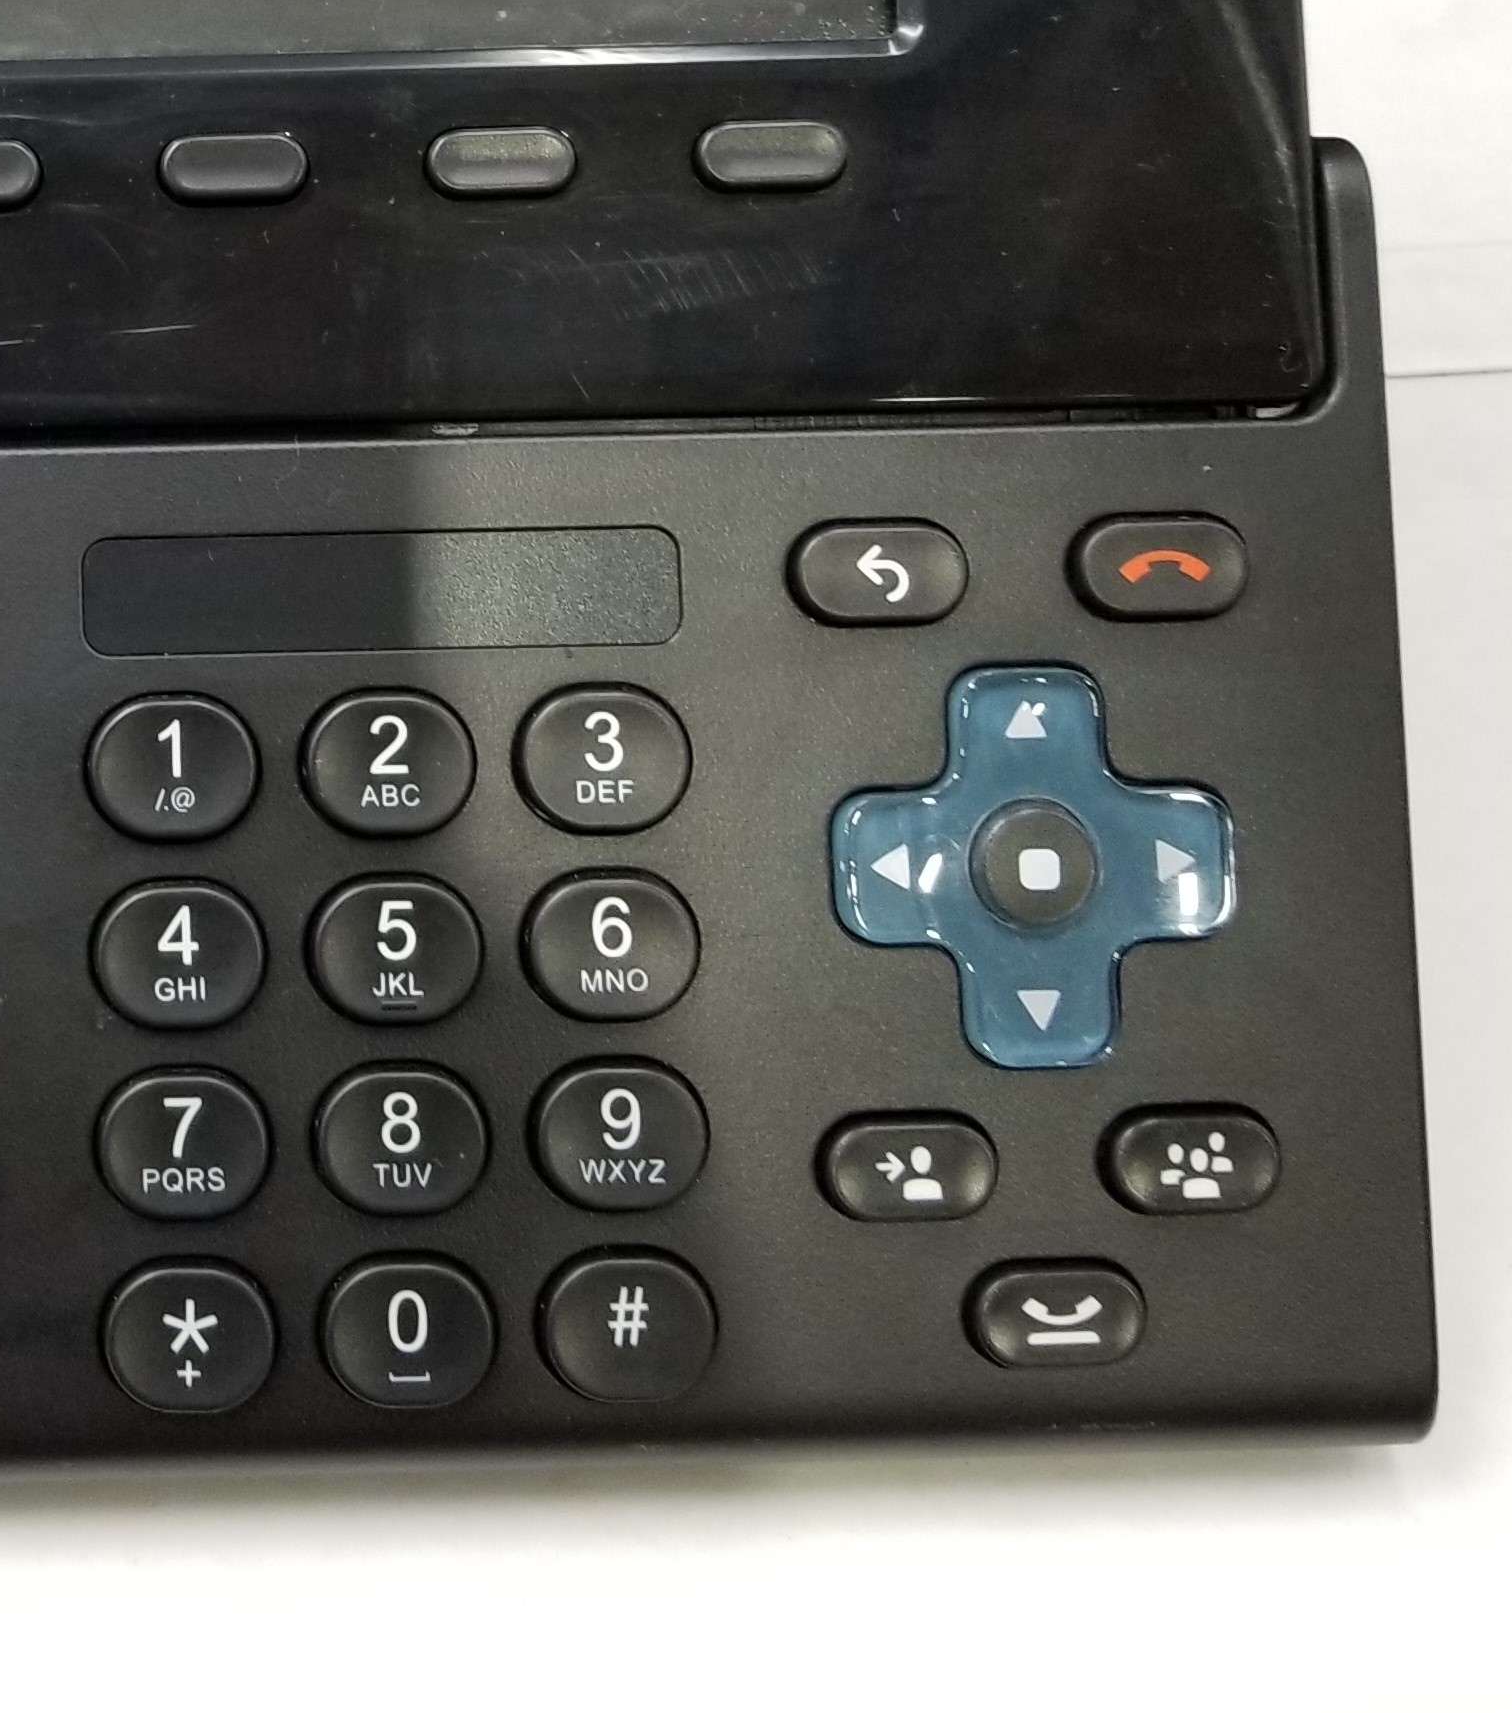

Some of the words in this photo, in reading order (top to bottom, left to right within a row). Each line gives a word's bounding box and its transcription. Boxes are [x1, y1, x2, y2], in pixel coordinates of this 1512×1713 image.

[157, 719, 182, 778] 1
[369, 714, 410, 775] 2
[583, 711, 625, 773] 3
[360, 783, 421, 808] ABC
[575, 779, 635, 804] DEF
[157, 905, 200, 966] 4
[376, 900, 417, 962] 5
[591, 896, 633, 959] 6
[154, 976, 206, 1002] GHI
[372, 971, 425, 997] JKL
[580, 967, 649, 994] MNO
[163, 1097, 203, 1159] 7
[381, 1091, 421, 1154] 8
[600, 1088, 641, 1151] 9
[142, 1166, 226, 1193] PQRS
[372, 1163, 432, 1188] TUV
[578, 1158, 666, 1184] WXYZ
[388, 1289, 428, 1353] 0
[607, 1286, 649, 1347] #
